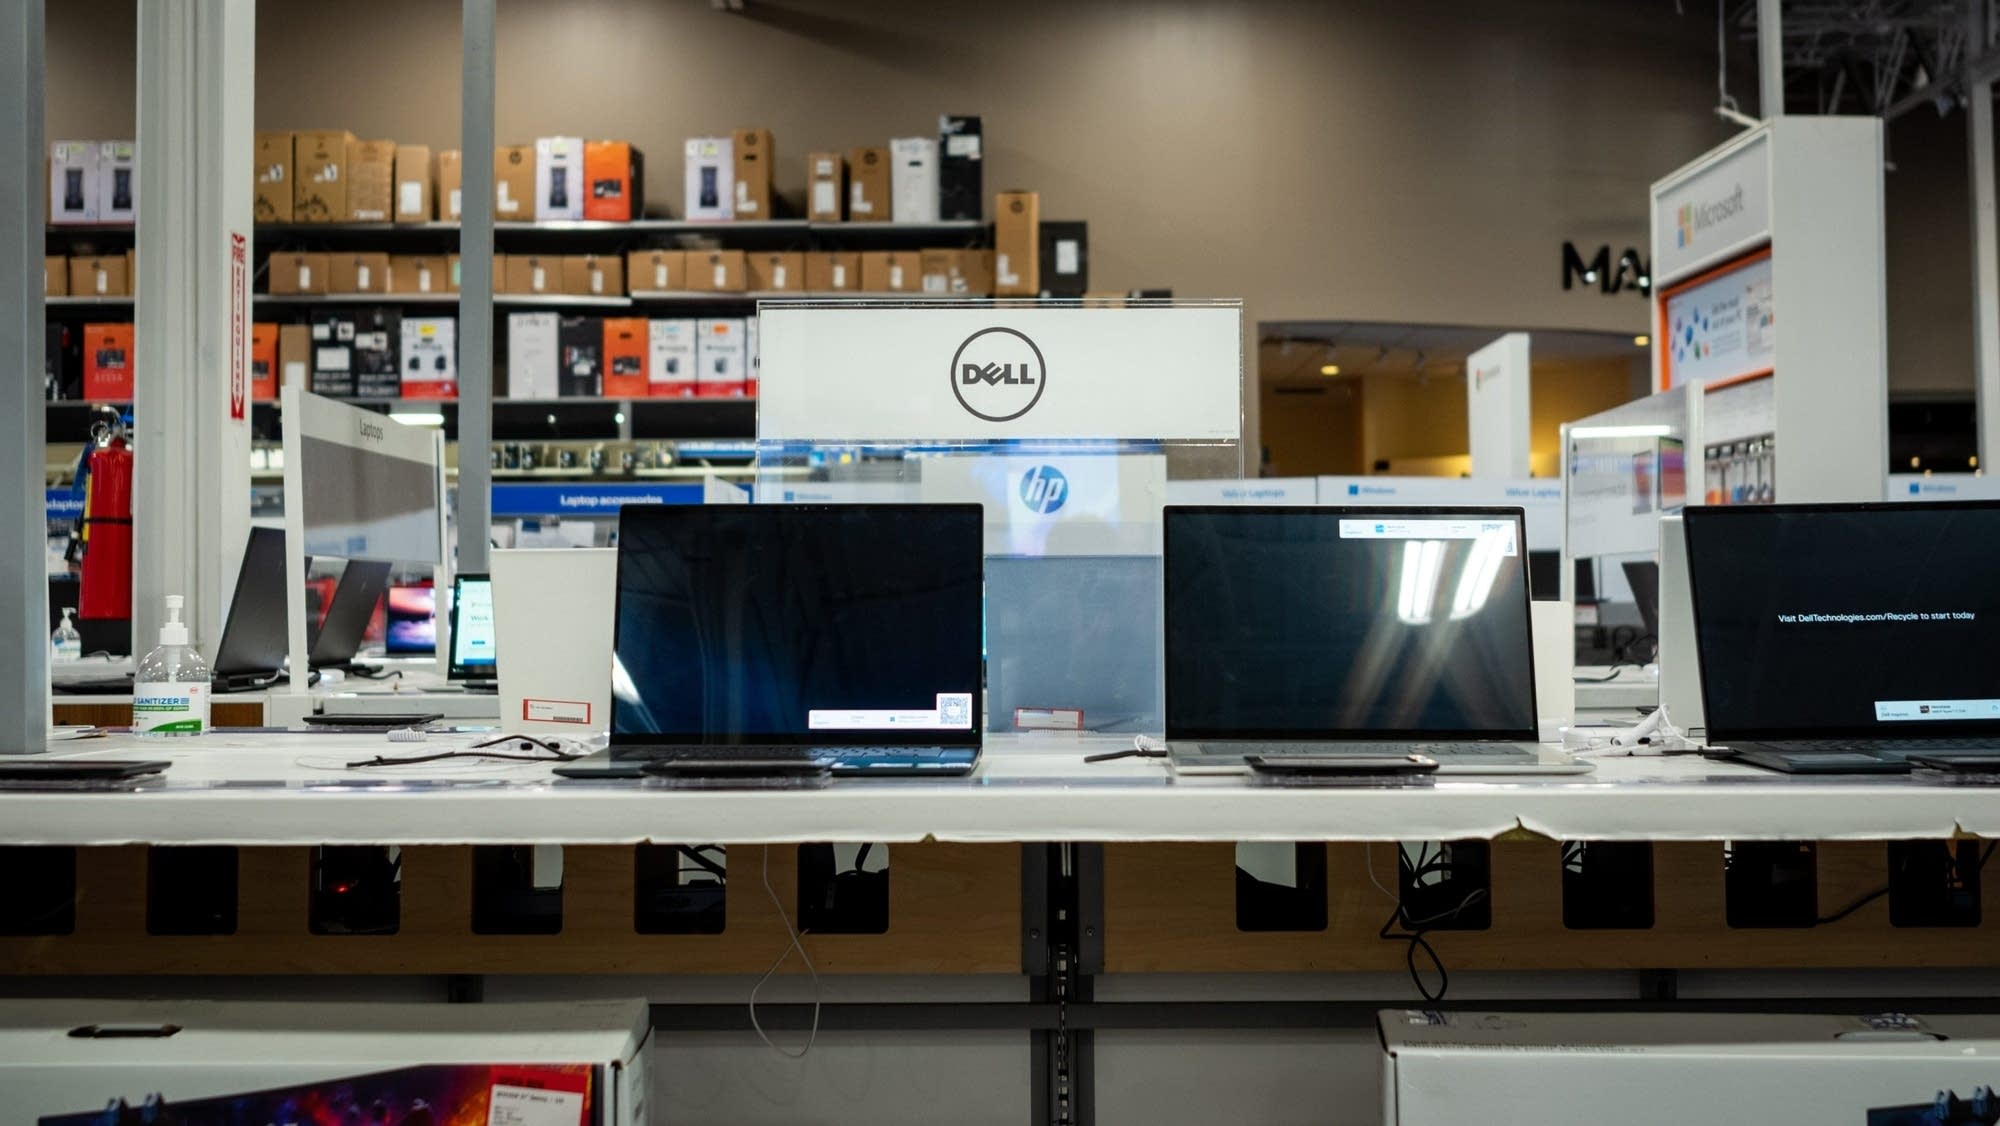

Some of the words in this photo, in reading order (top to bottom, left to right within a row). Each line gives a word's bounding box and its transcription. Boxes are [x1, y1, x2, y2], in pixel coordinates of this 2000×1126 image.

[1694, 182, 1744, 231] Microsoft
[1562, 241, 1651, 298] MA
[962, 361, 1035, 386] DELL
[359, 418, 384, 444] Laptops
[560, 494, 598, 508] Laptop
[600, 494, 663, 505] accessories
[1021, 464, 1067, 513] hp
[1778, 614, 1797, 623] Visit
[1920, 612, 1930, 620] to
[1930, 612, 1951, 620] start
[1952, 611, 1975, 620] today
[137, 697, 180, 705] SANITIZER
